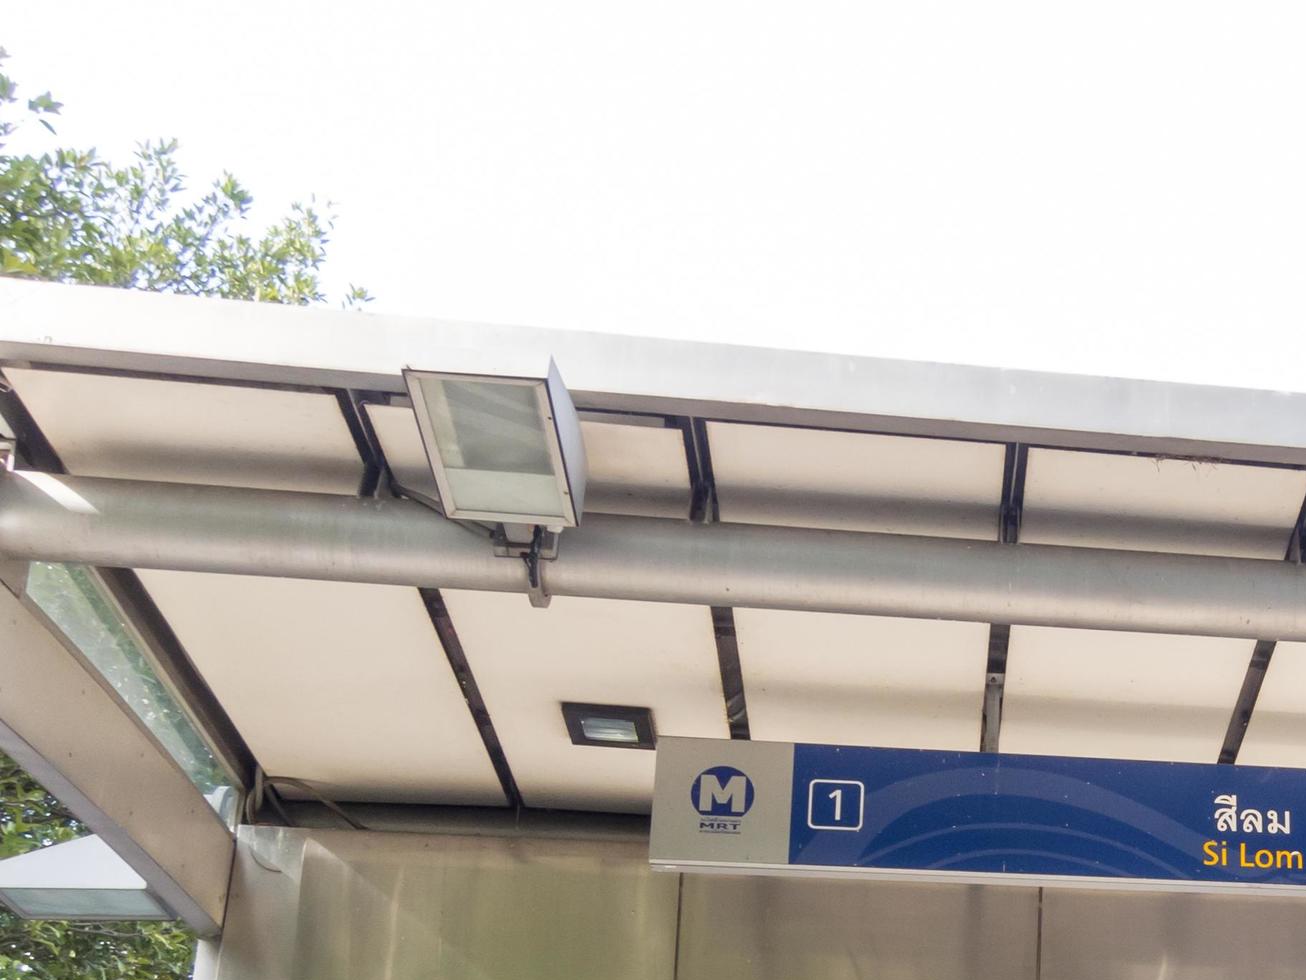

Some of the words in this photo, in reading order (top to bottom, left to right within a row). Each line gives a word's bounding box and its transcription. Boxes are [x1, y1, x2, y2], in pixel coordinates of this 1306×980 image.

[698, 774, 747, 813] M
[828, 789, 842, 821] 1
[699, 822, 741, 831] MRT
[1214, 794, 1291, 834] สีลม
[1201, 840, 1228, 866] Si
[1239, 842, 1304, 870] Lom
